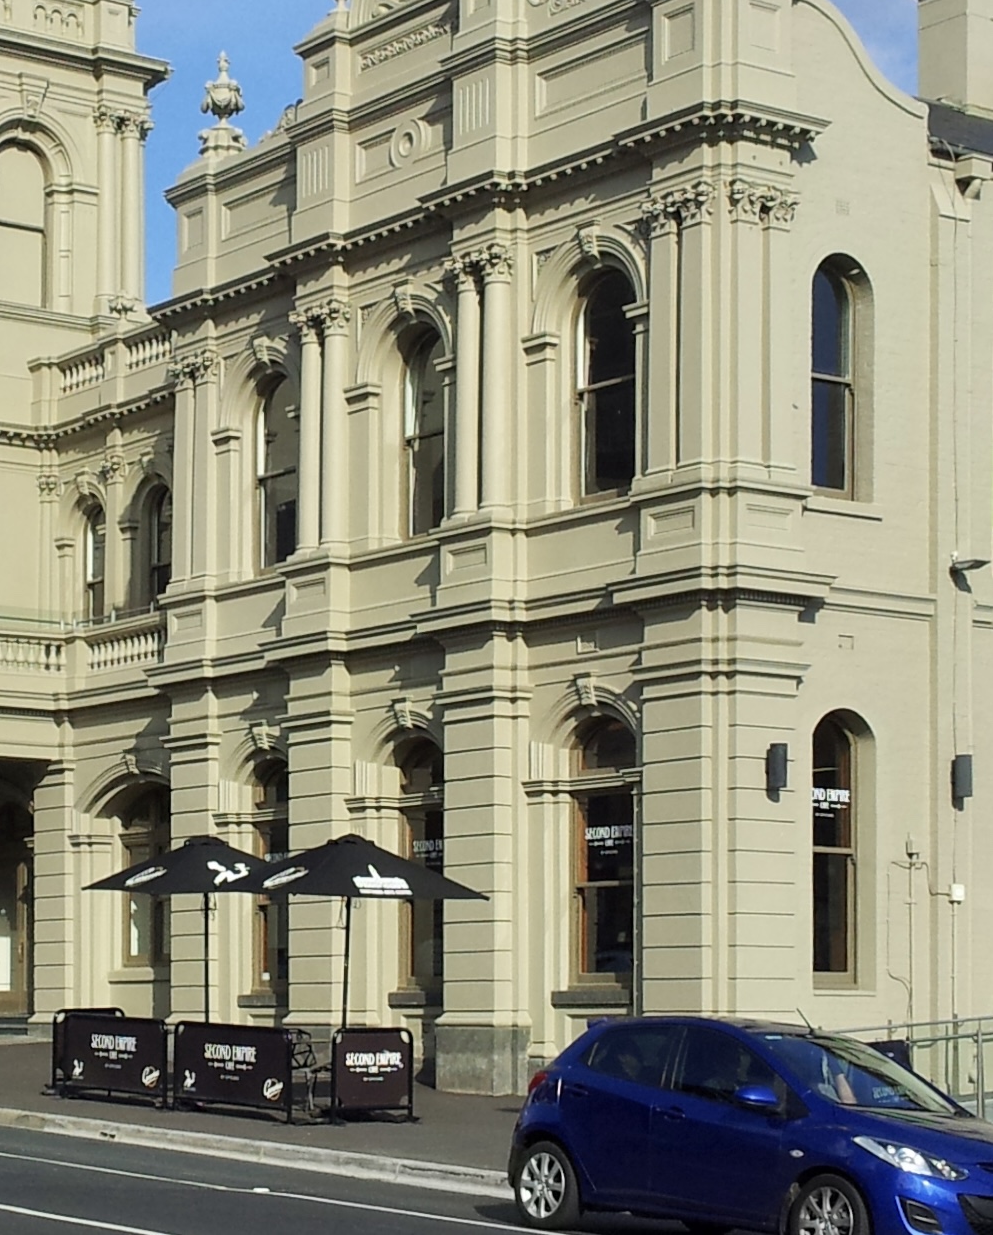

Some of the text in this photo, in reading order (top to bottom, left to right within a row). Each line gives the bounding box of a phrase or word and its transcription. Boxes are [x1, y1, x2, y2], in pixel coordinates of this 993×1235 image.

[826, 788, 851, 803] EMPIRE
[584, 826, 611, 840] SECOND
[91, 1033, 137, 1052] SECOND EMPIRE
[204, 1043, 257, 1063] SECOND EMPIRE
[345, 1051, 402, 1066] SECOND EMPIRE
